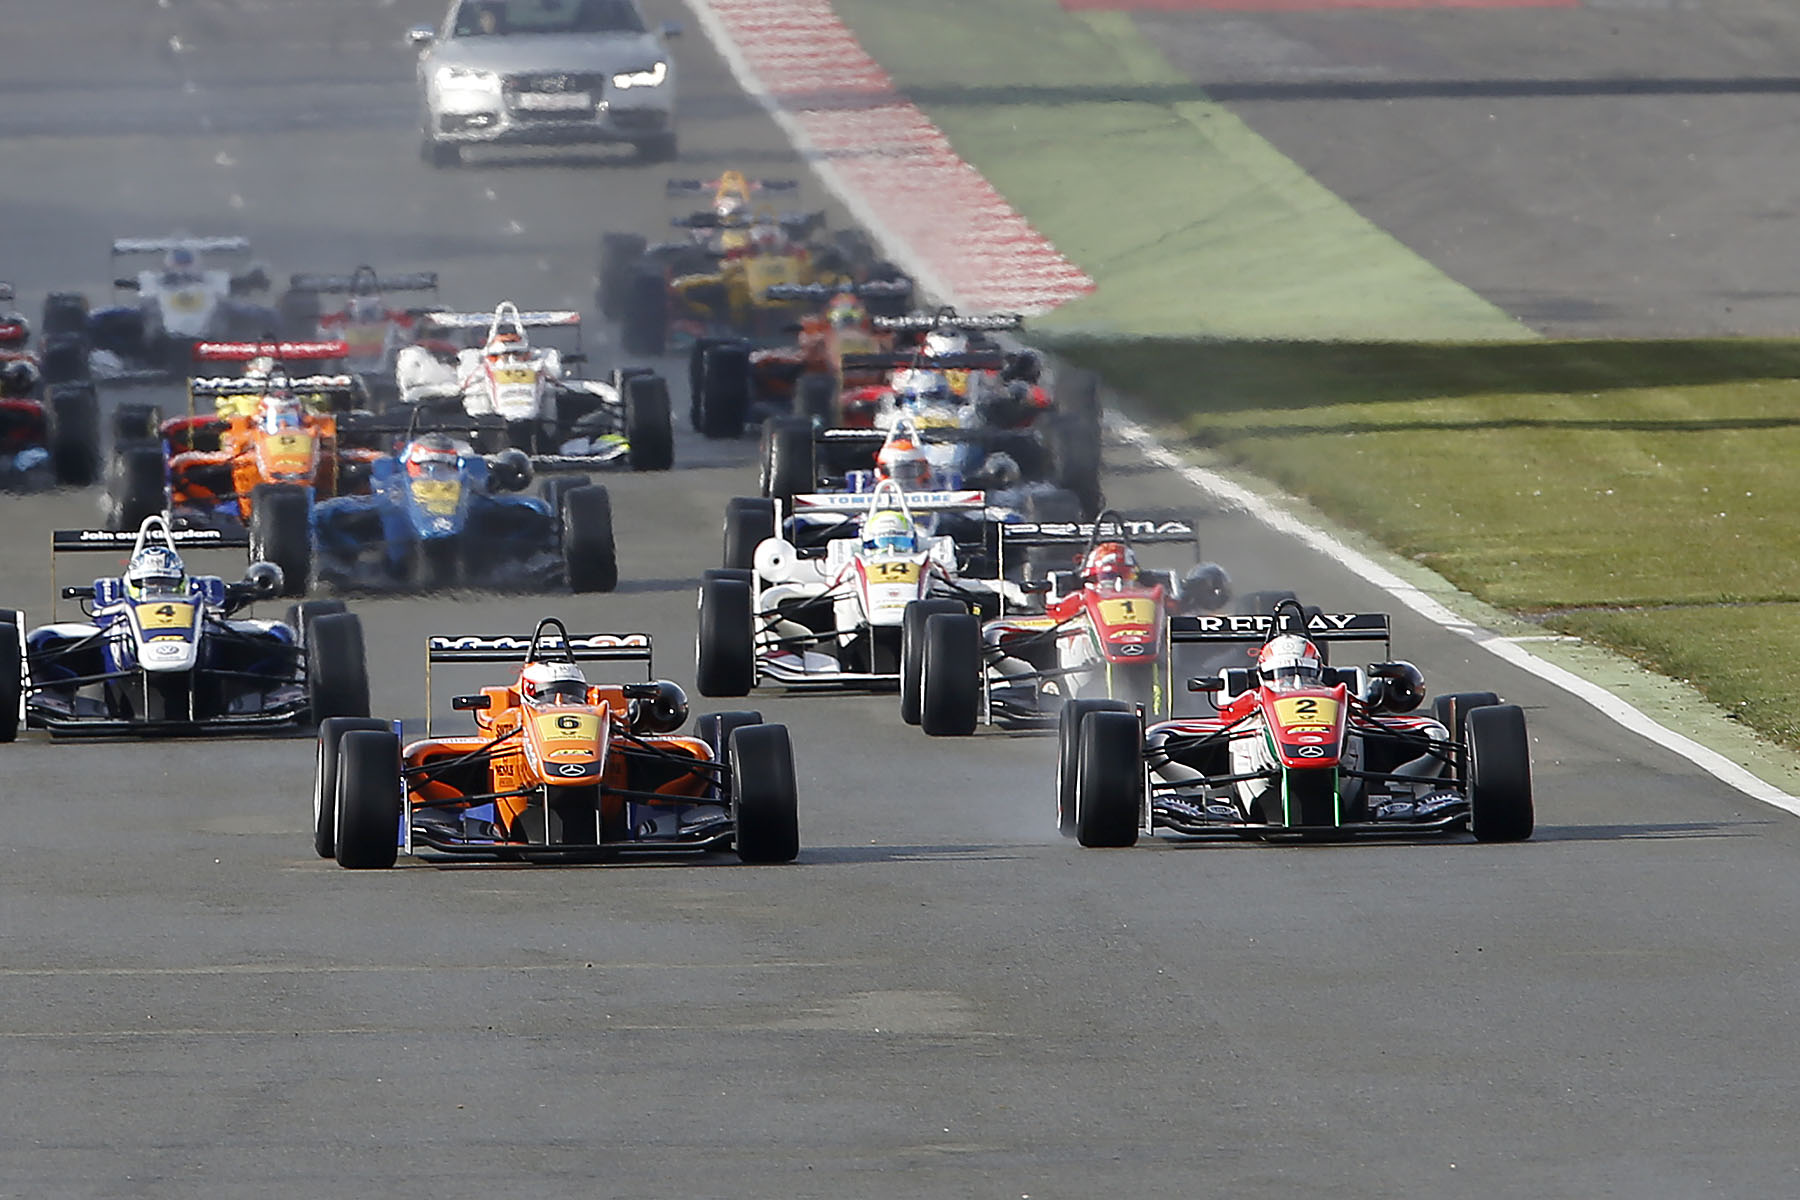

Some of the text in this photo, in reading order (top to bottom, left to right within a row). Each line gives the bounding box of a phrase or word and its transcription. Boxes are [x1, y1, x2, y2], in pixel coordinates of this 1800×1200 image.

[80, 530, 114, 541] Join
[146, 529, 221, 541] Kigdom
[875, 563, 910, 575] 14
[155, 605, 176, 617] 4
[1120, 601, 1134, 613] 1
[1295, 699, 1318, 714] 2
[556, 715, 580, 730] 6
